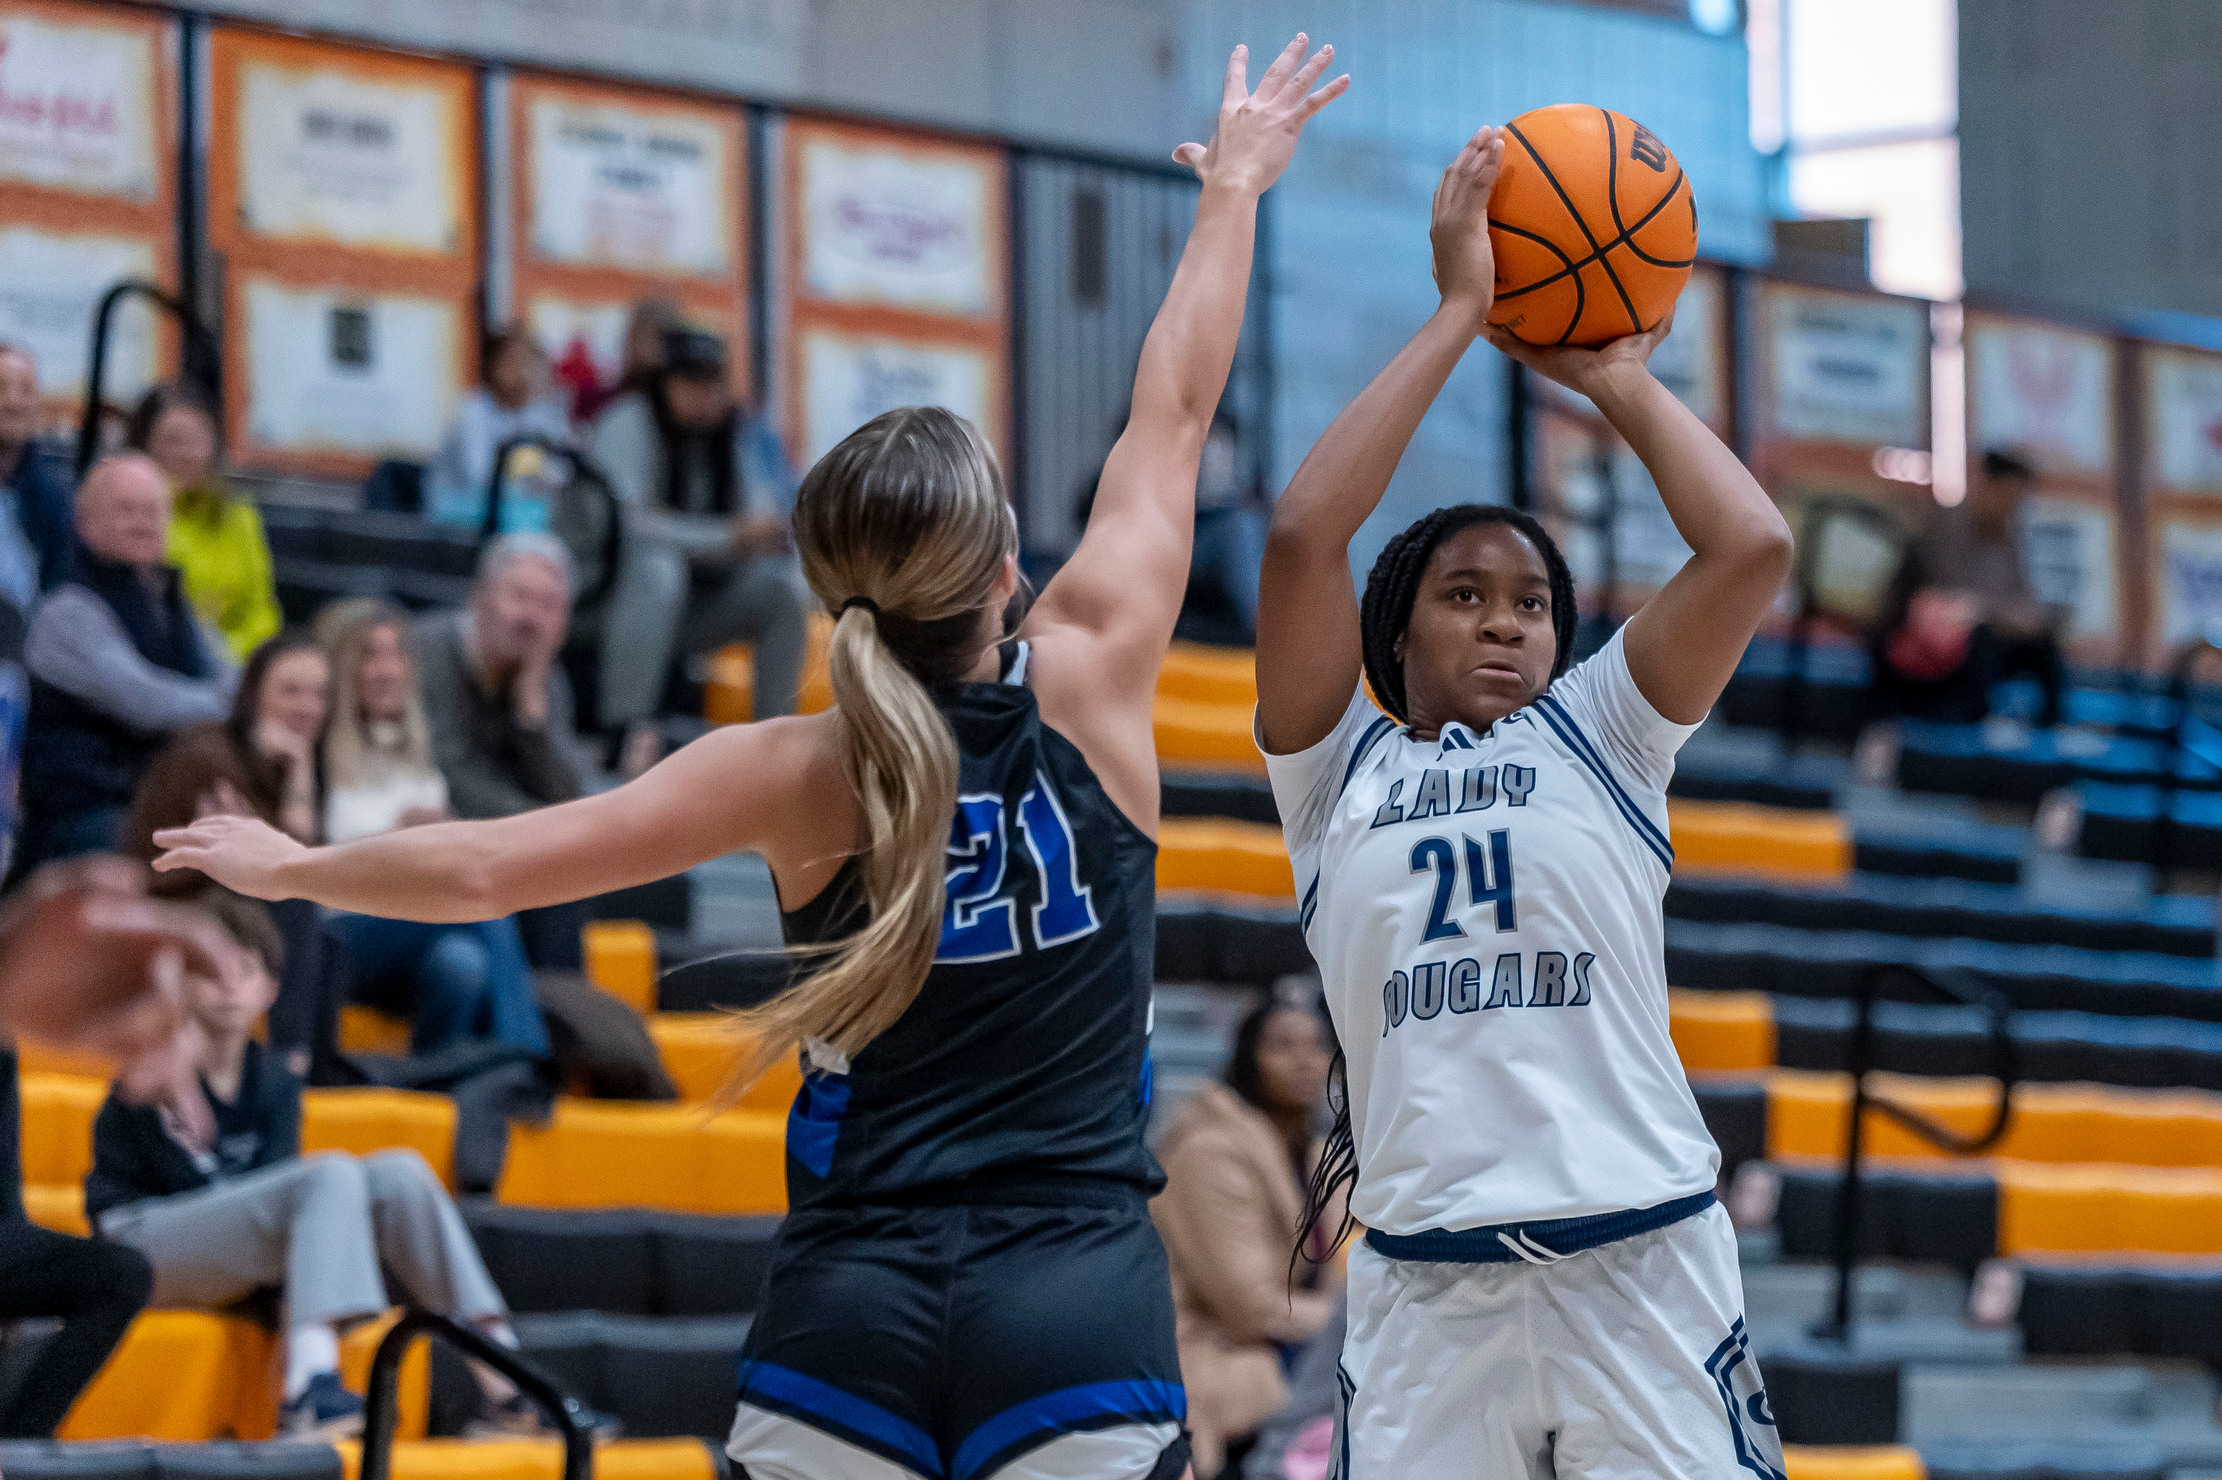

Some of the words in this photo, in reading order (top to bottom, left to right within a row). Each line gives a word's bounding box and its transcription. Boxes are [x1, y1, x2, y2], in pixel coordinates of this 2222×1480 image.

[1369, 763, 1536, 829] LADY
[931, 768, 1101, 964] 21
[1409, 827, 1519, 946] 24
